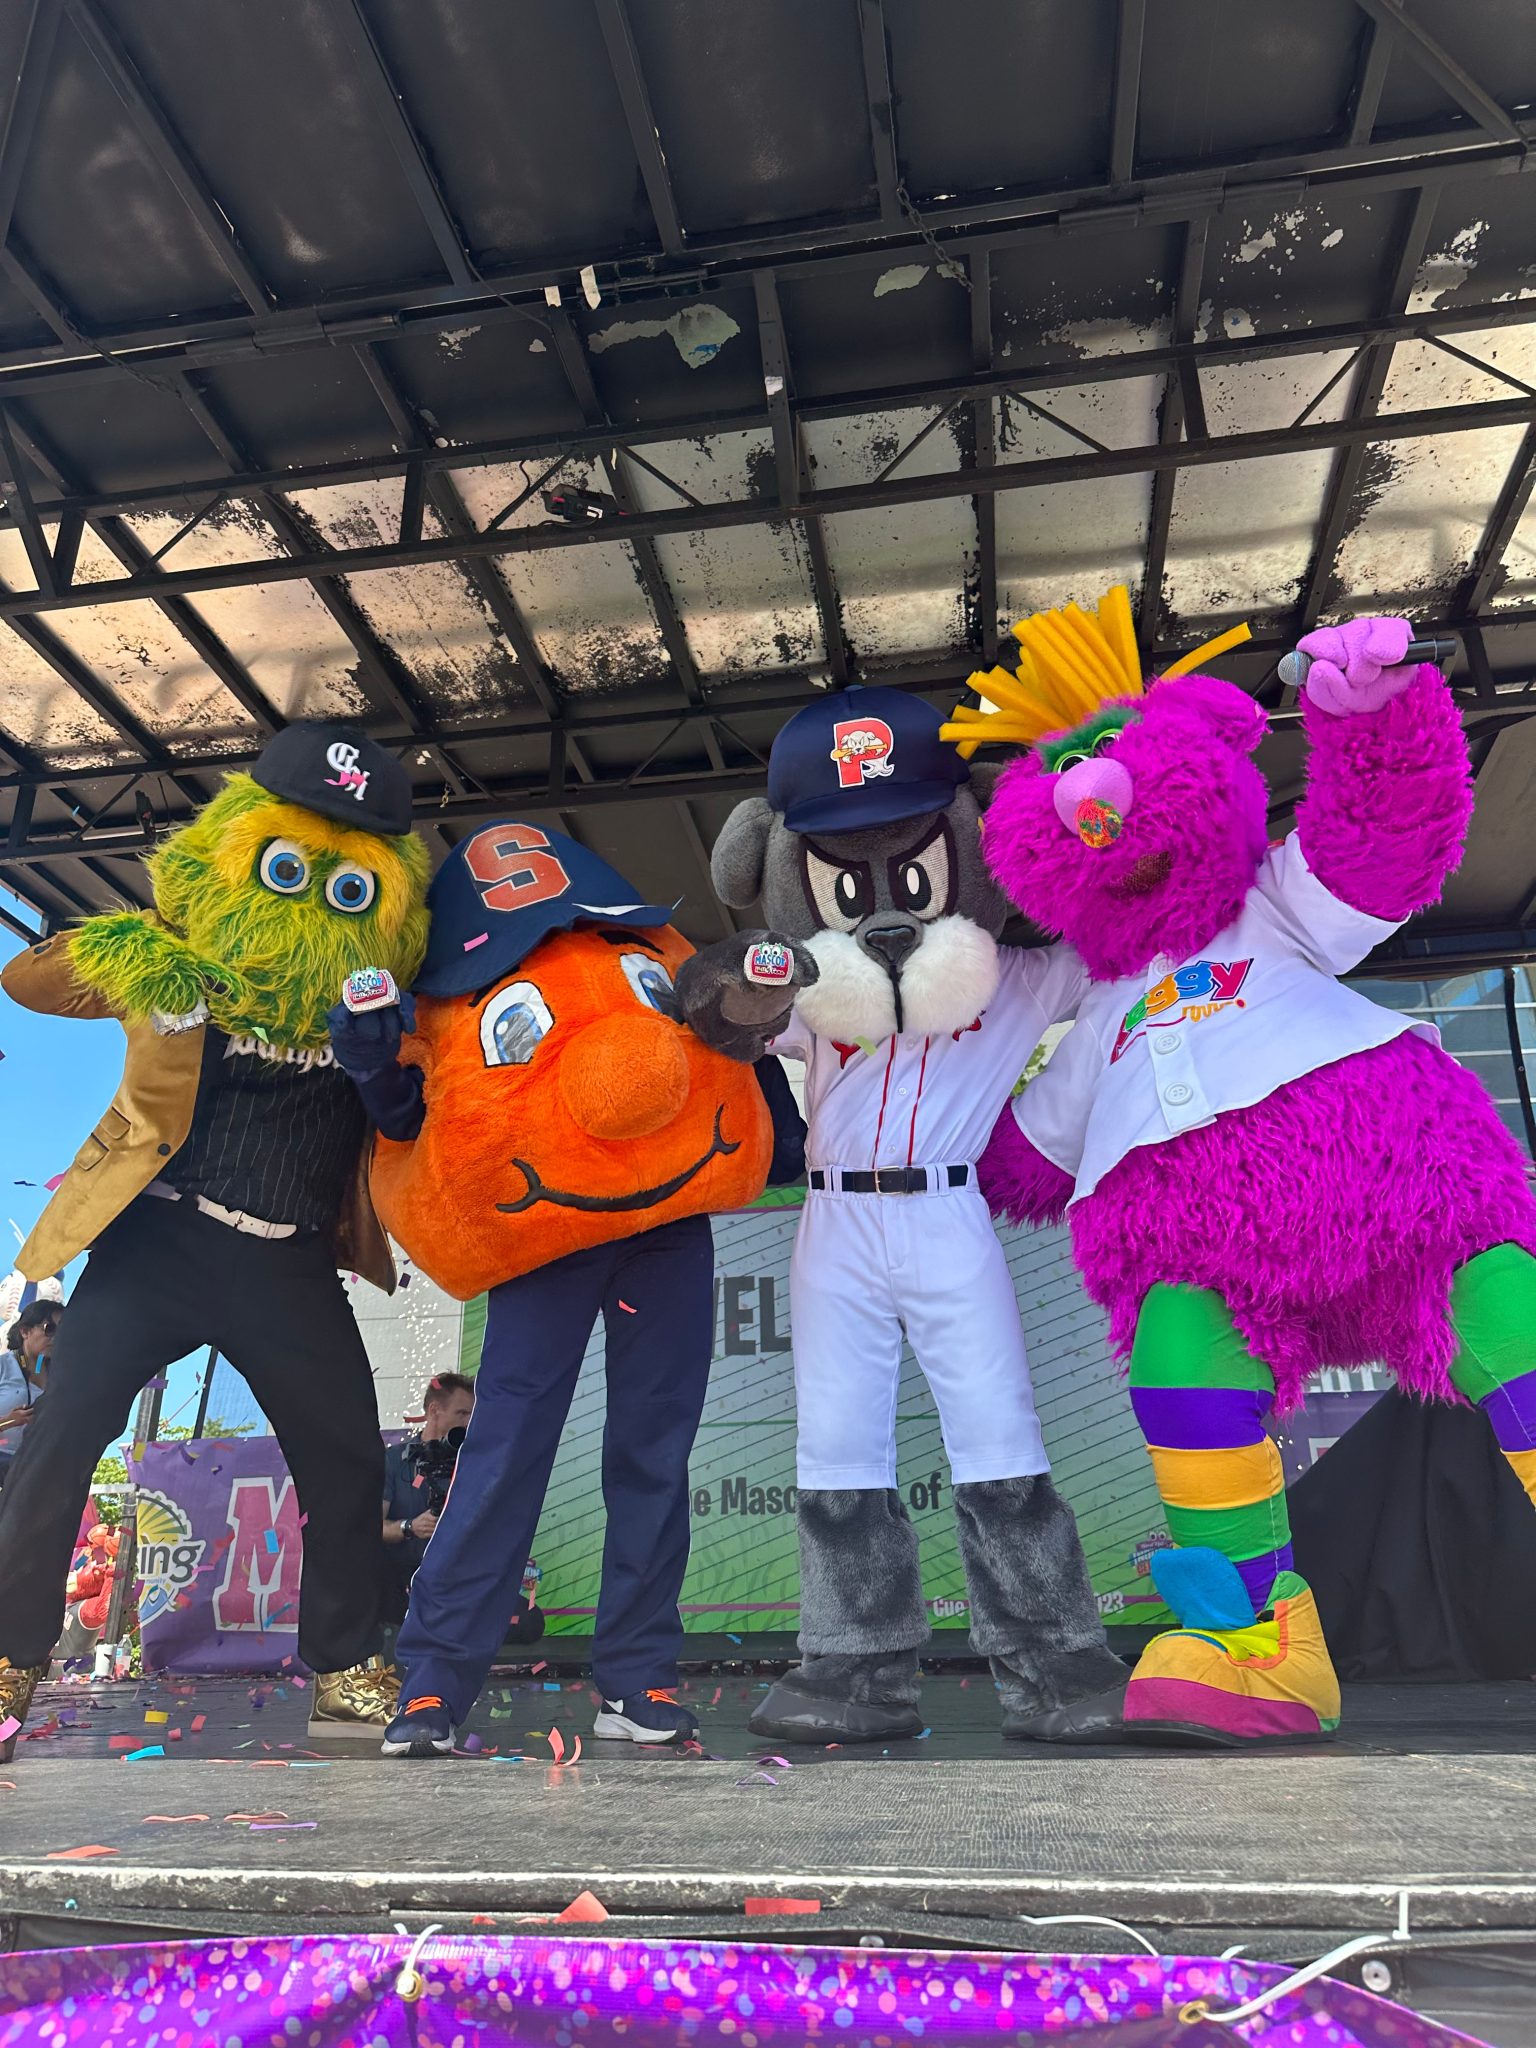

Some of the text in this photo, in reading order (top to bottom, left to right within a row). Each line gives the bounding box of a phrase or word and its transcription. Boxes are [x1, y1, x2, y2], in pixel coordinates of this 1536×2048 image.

[833, 717, 894, 788] P
[463, 823, 571, 912] S
[712, 1276, 791, 1358] EL
[909, 1471, 942, 1510] of
[933, 1595, 965, 1617] Cue
